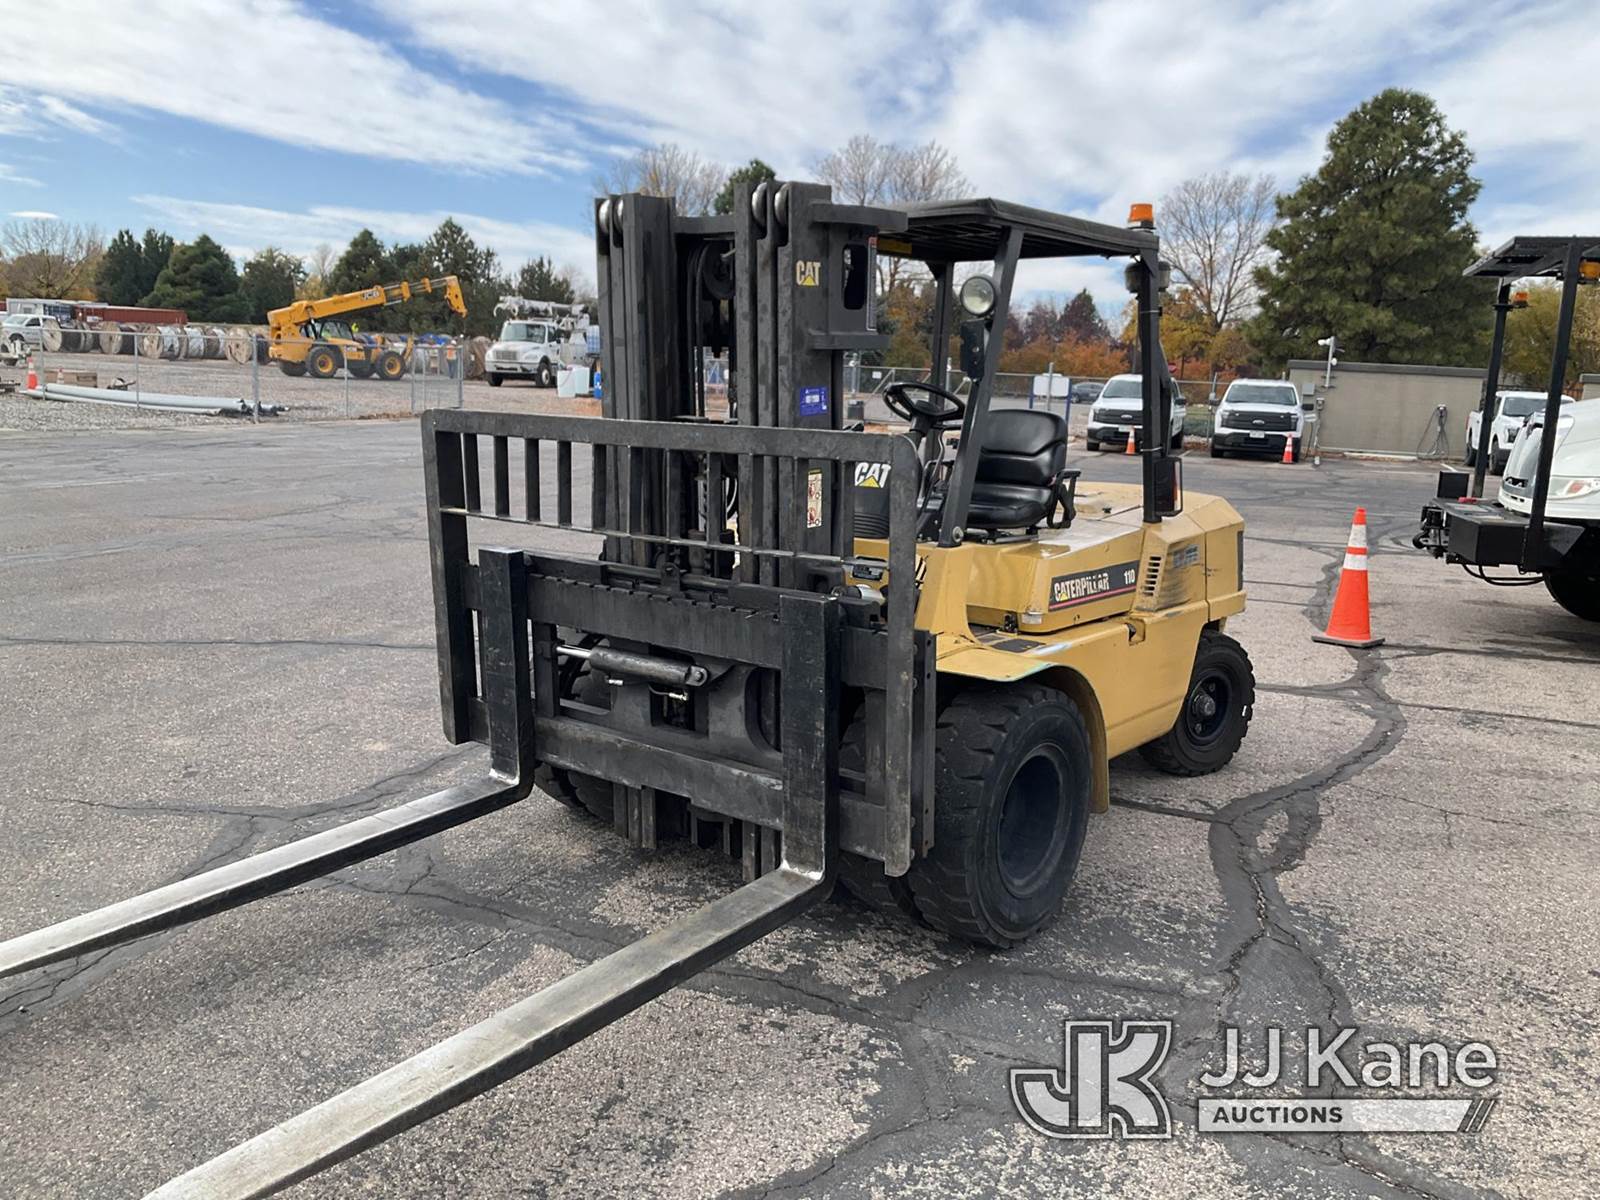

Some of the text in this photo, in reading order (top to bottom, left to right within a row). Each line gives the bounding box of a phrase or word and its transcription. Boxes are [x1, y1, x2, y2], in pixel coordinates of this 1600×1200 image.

[796, 260, 821, 287] CAT
[855, 462, 891, 489] CAT
[1054, 569, 1136, 602] CATERPILLAR 110
